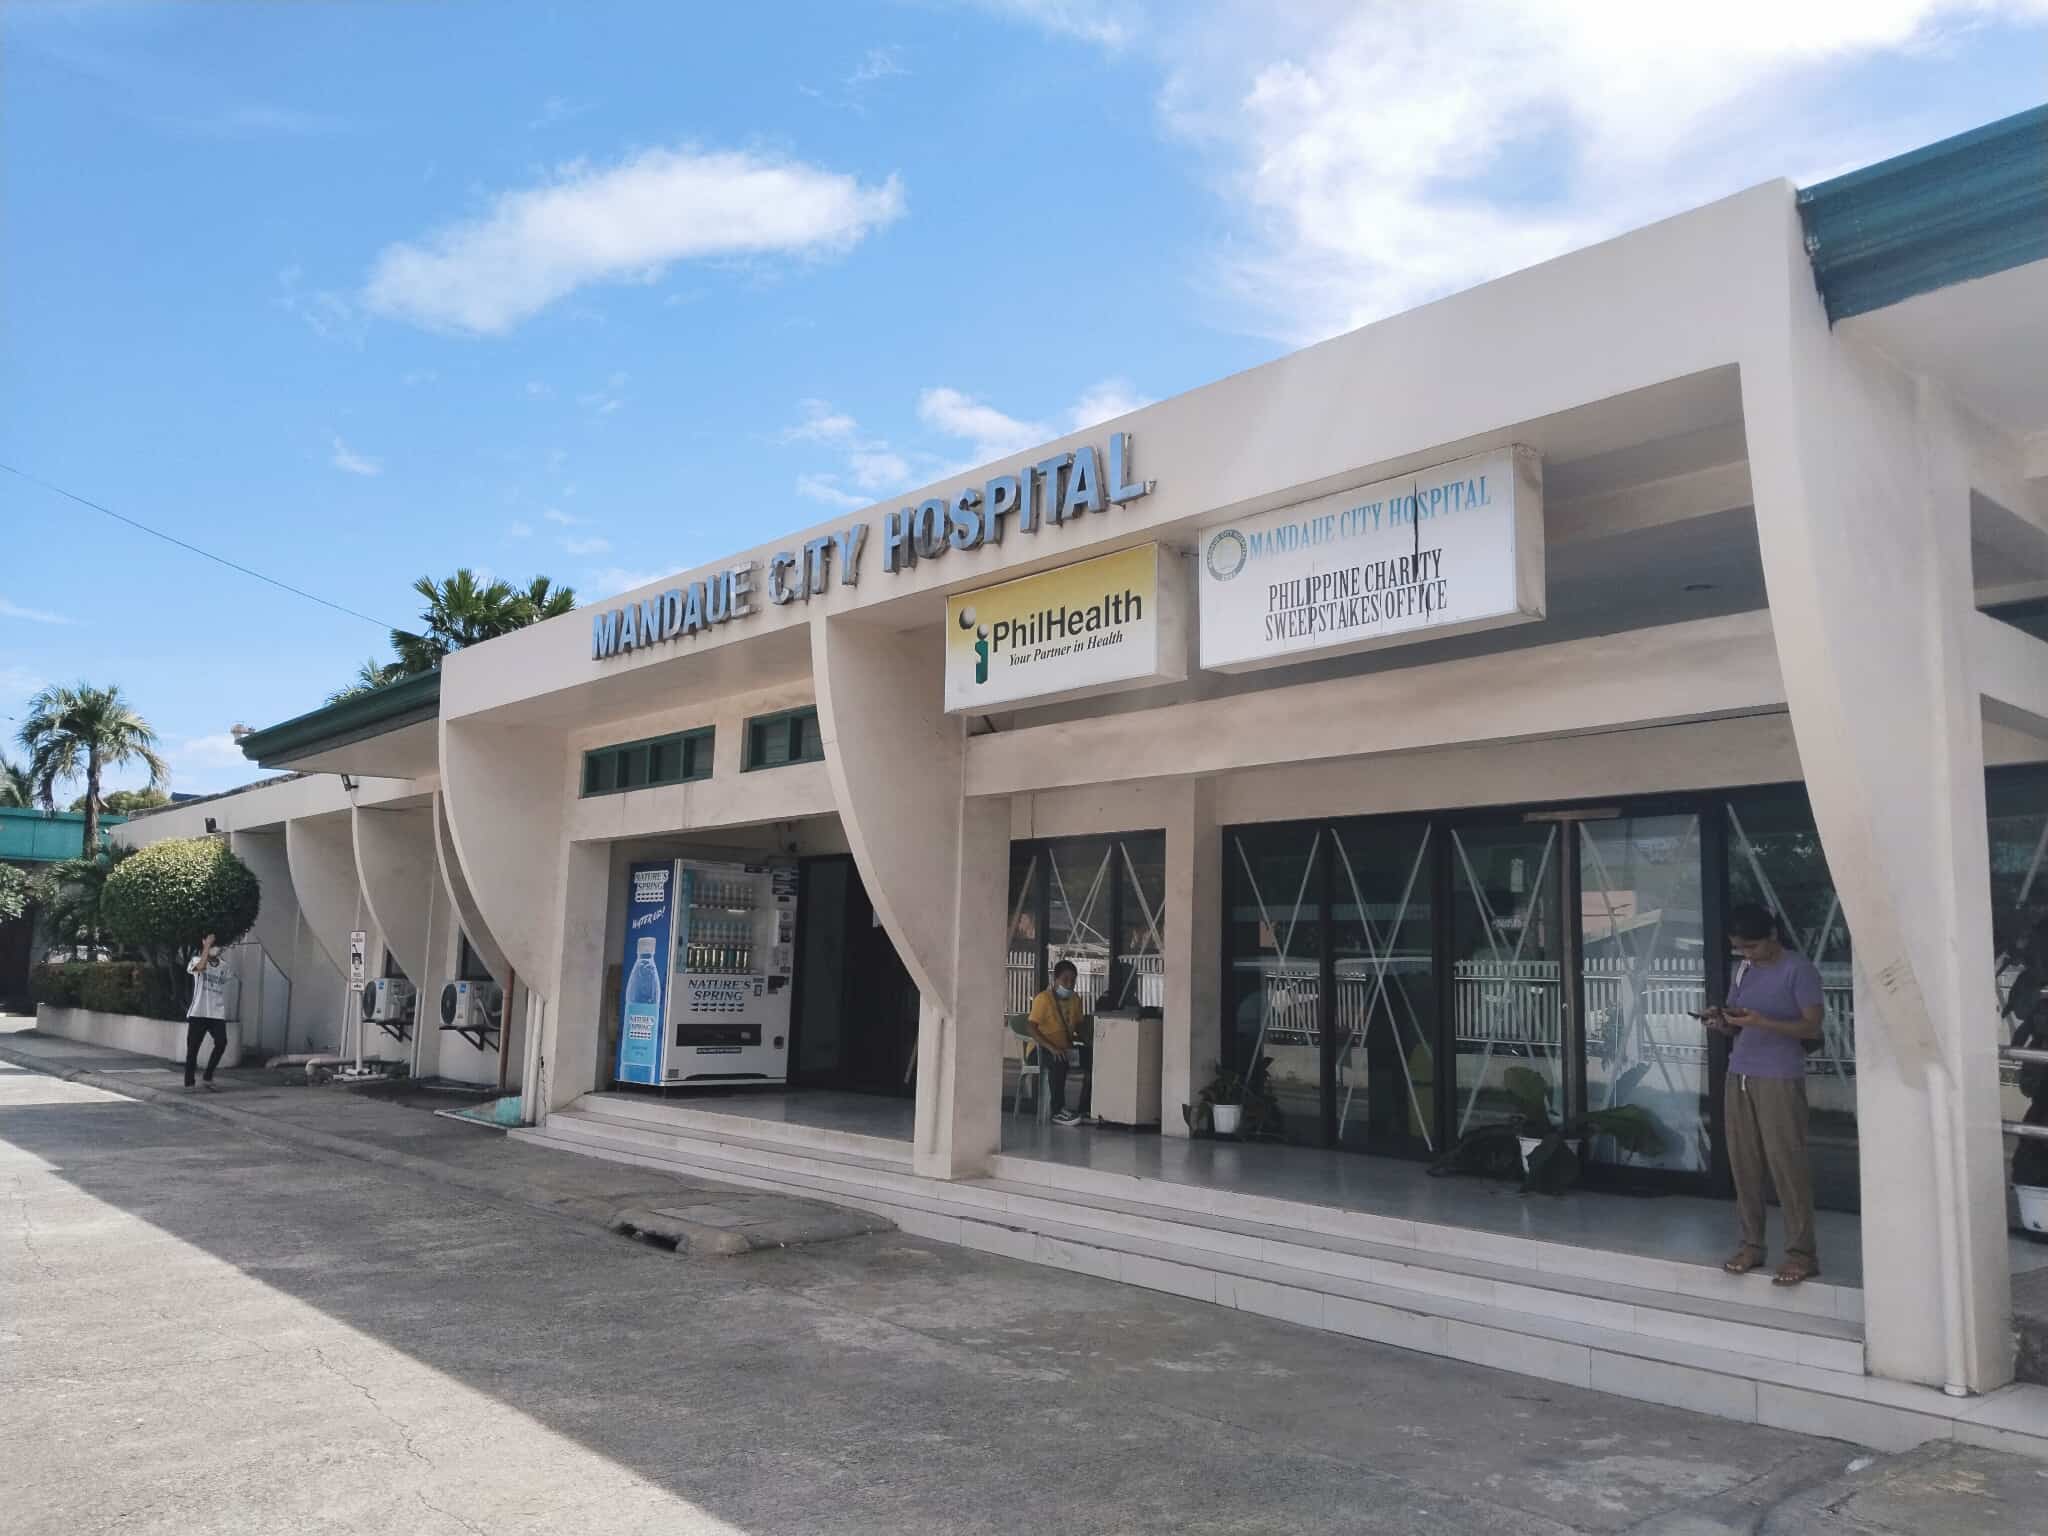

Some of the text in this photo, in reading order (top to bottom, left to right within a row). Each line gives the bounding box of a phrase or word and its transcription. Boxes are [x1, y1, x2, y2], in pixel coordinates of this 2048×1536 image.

[1249, 513, 1337, 561] MANDAUE
[1340, 502, 1383, 537] CITY
[1389, 476, 1491, 530] HOSPITAL
[591, 560, 761, 660] MANDAUE
[768, 523, 868, 605] CITY
[883, 432, 1154, 573] HOSPITAL
[1268, 548, 1442, 613] PHILIPPINE CHARITY
[993, 588, 1143, 653] PhilHealth
[1265, 579, 1447, 642] SWEEPSTAKES OFFICE
[1009, 630, 1124, 667] Your Partner in Health
[634, 870, 669, 882] NATURE'S
[637, 882, 664, 890] SPRING
[688, 978, 751, 990] NATURE'S
[693, 990, 743, 1001] SPRING
